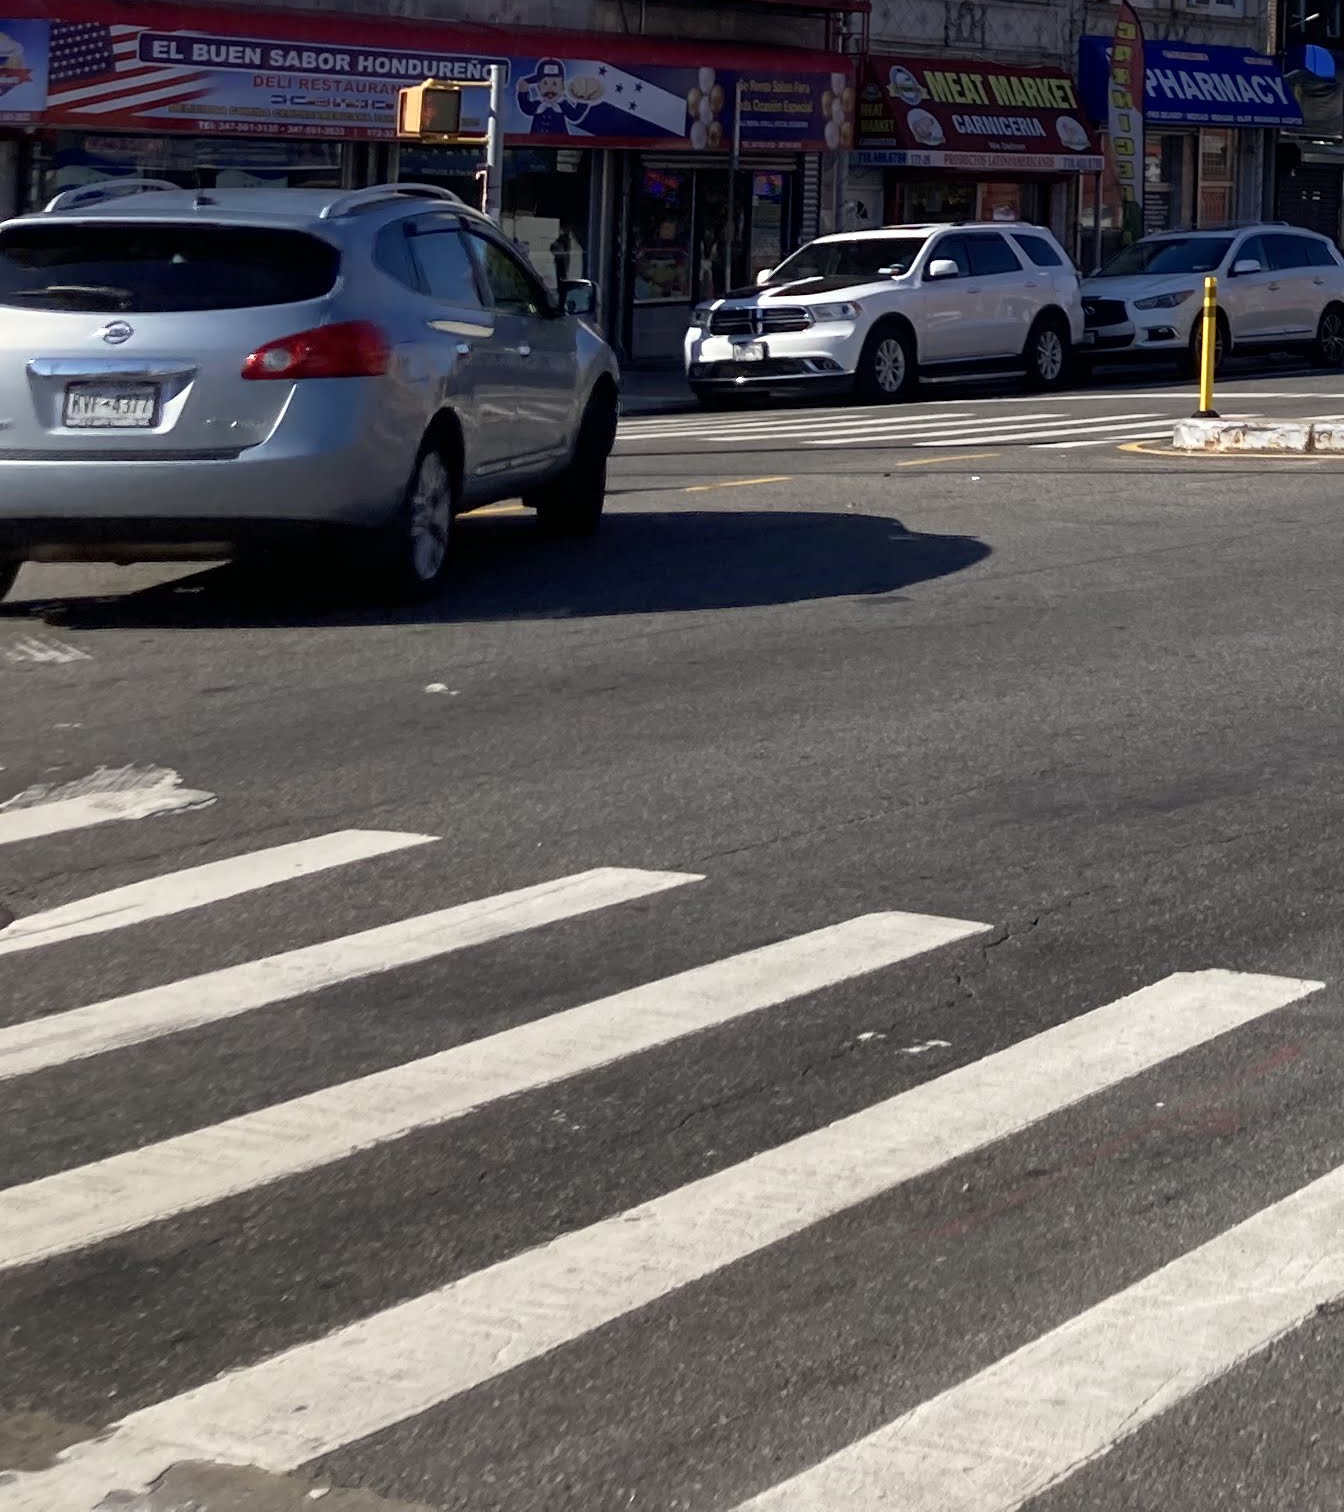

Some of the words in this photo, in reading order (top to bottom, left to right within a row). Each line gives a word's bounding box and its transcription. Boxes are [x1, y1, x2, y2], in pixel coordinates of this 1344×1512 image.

[152, 39, 184, 61] EL
[192, 42, 262, 65] BUEN
[269, 48, 351, 72] SABOR
[253, 74, 293, 89] DELI
[298, 75, 401, 97] RESTAURAN
[922, 70, 990, 105] MEAT
[987, 74, 1078, 109] MARKET
[1145, 67, 1290, 105] PHARMACY
[951, 113, 1047, 137] CARNICERIA
